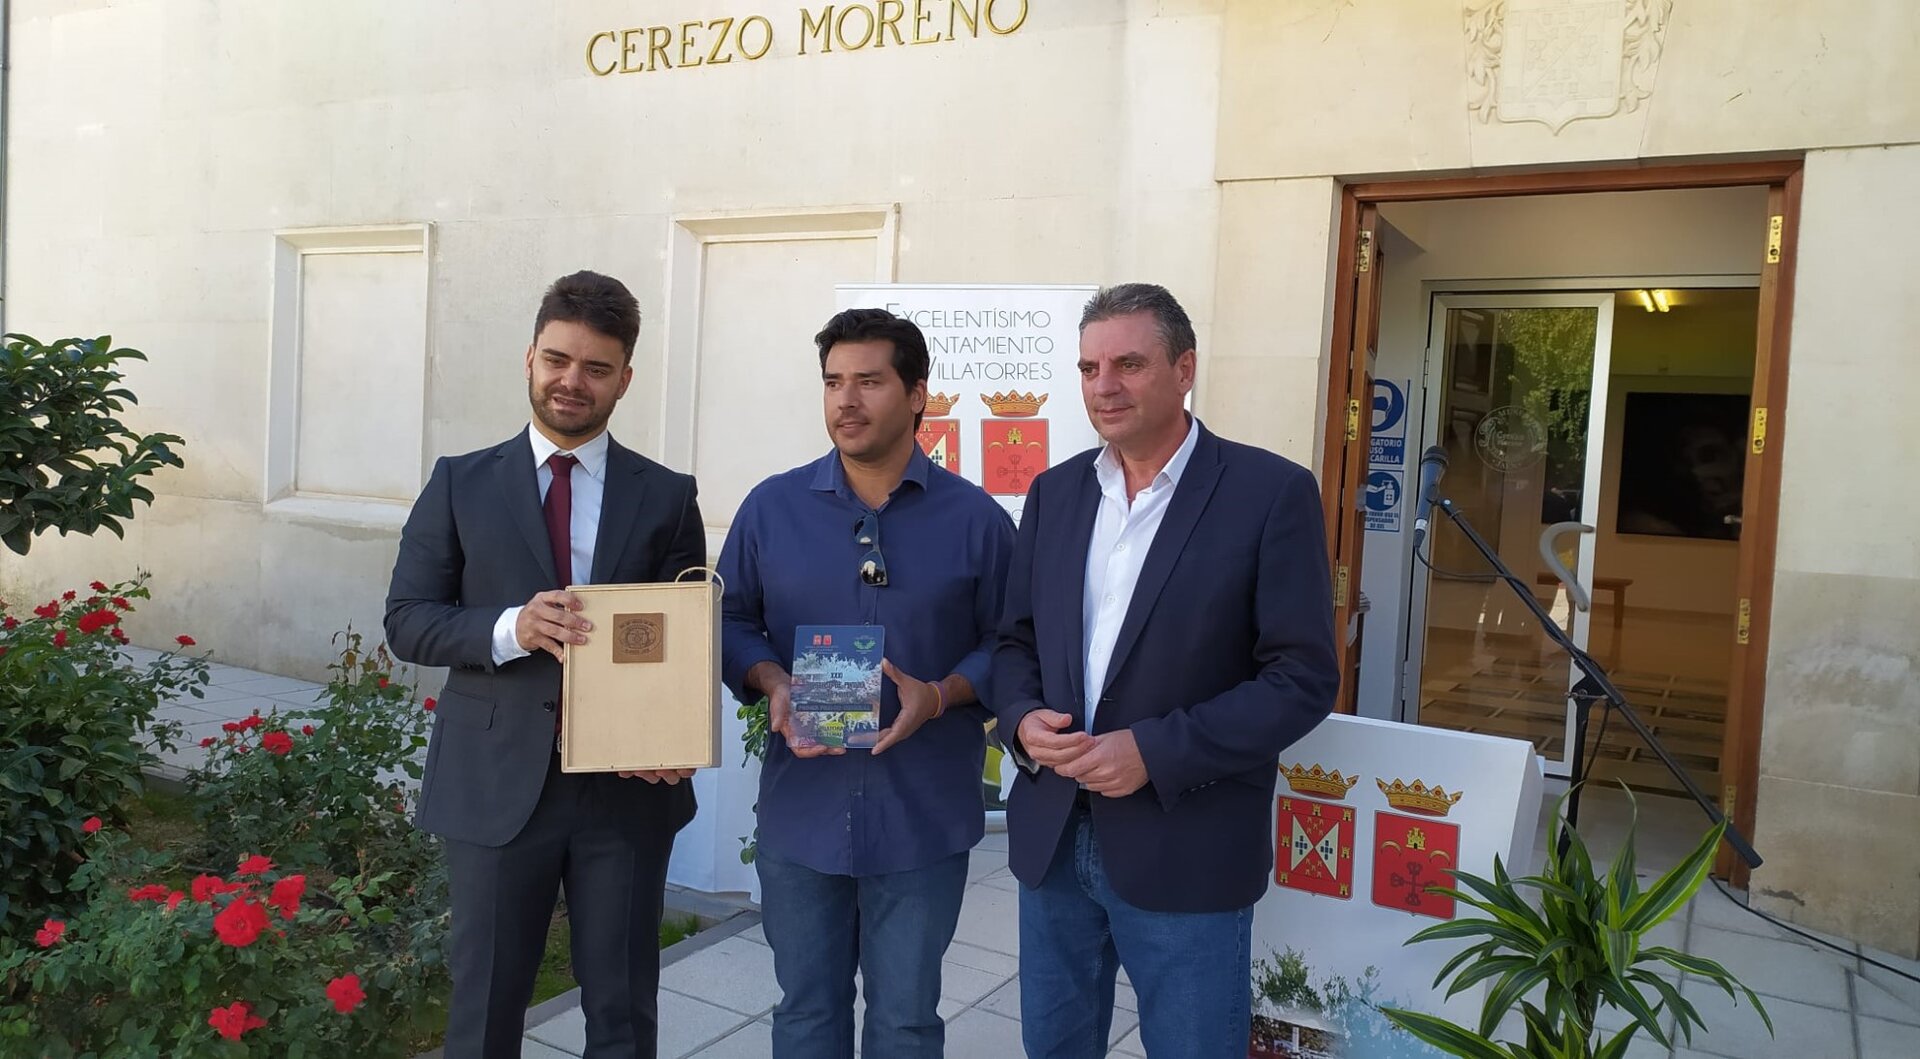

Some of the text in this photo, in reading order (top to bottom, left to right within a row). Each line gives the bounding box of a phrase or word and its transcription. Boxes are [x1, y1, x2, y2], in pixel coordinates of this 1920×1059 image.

[585, 0, 1028, 76] CEREZO MORENO
[928, 336, 1054, 354] NTAMIENTO
[1370, 438, 1402, 448] GATORIO
[1370, 454, 1400, 464] CARILLA
